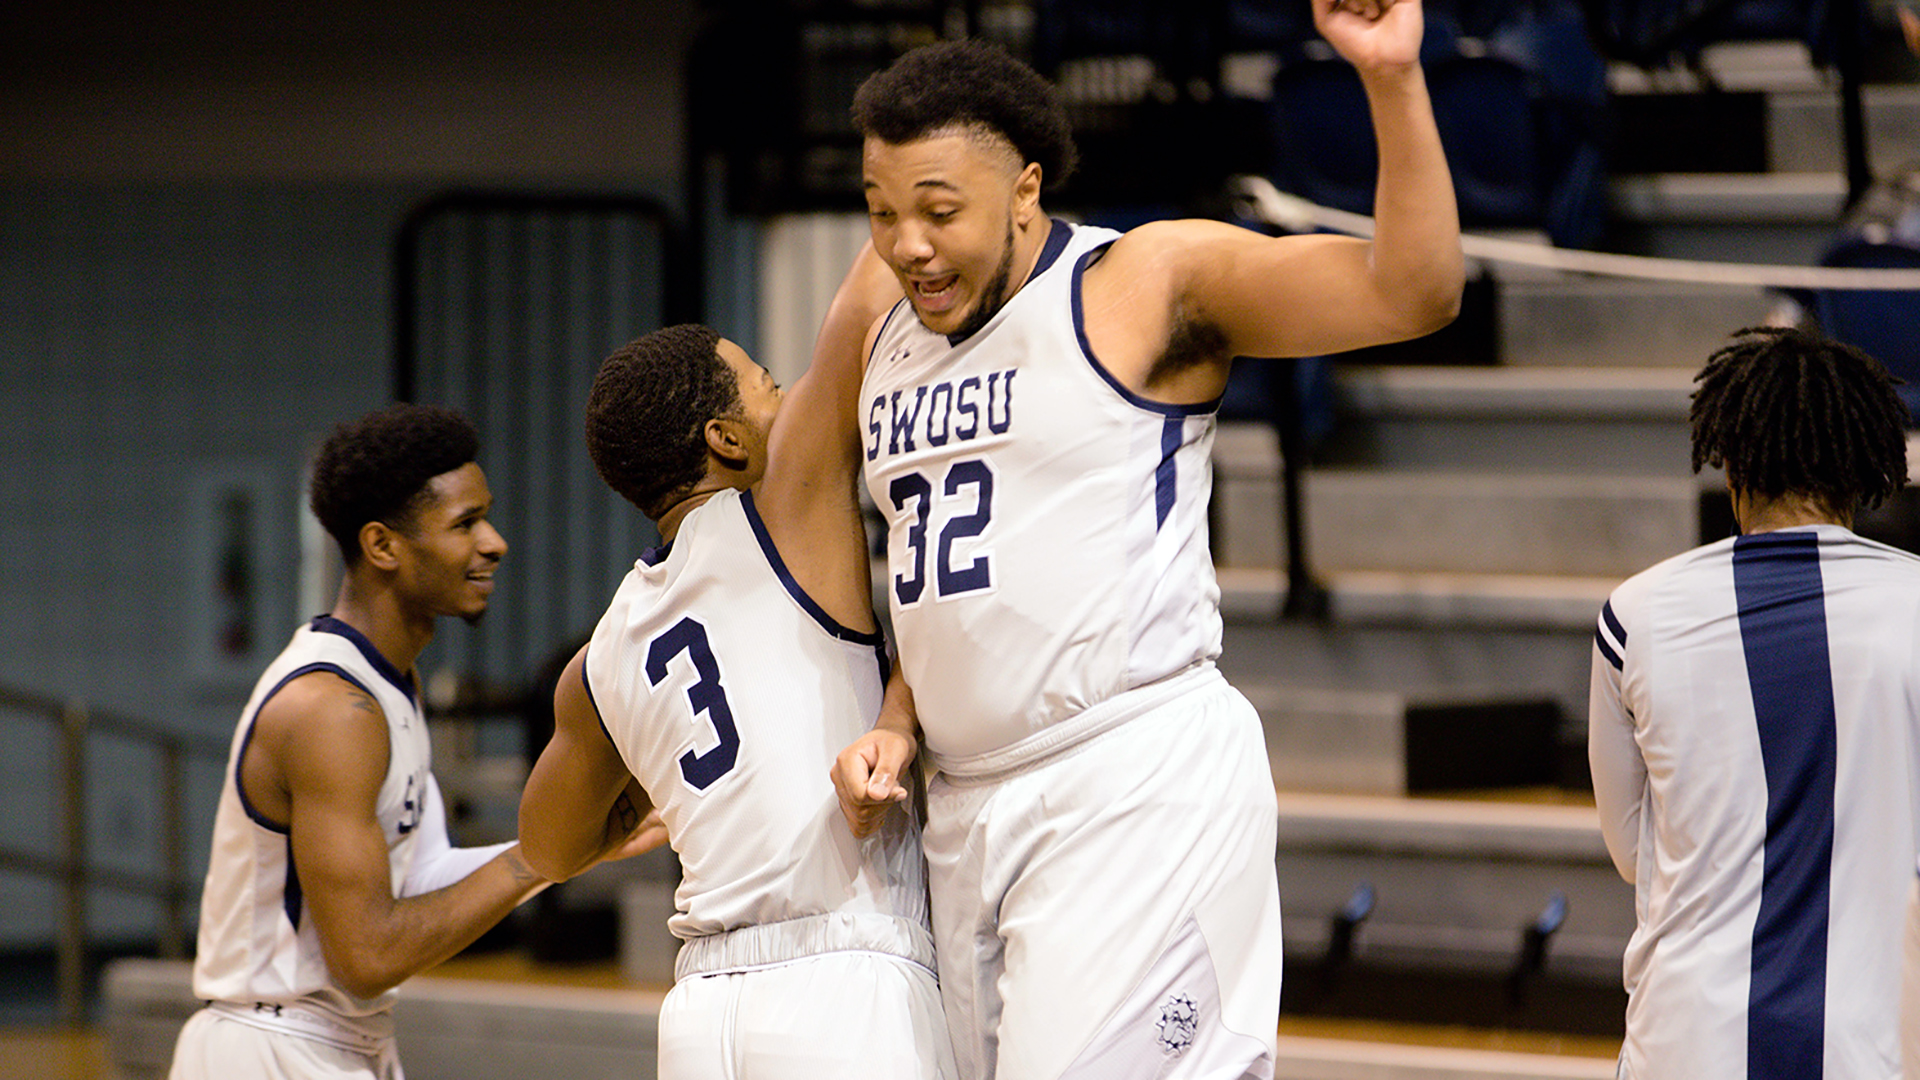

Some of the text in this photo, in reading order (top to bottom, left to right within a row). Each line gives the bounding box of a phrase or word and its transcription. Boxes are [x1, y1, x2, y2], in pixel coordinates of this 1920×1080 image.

[866, 367, 1018, 462] SWOSU
[888, 458, 995, 606] 32
[643, 614, 742, 793] 3
